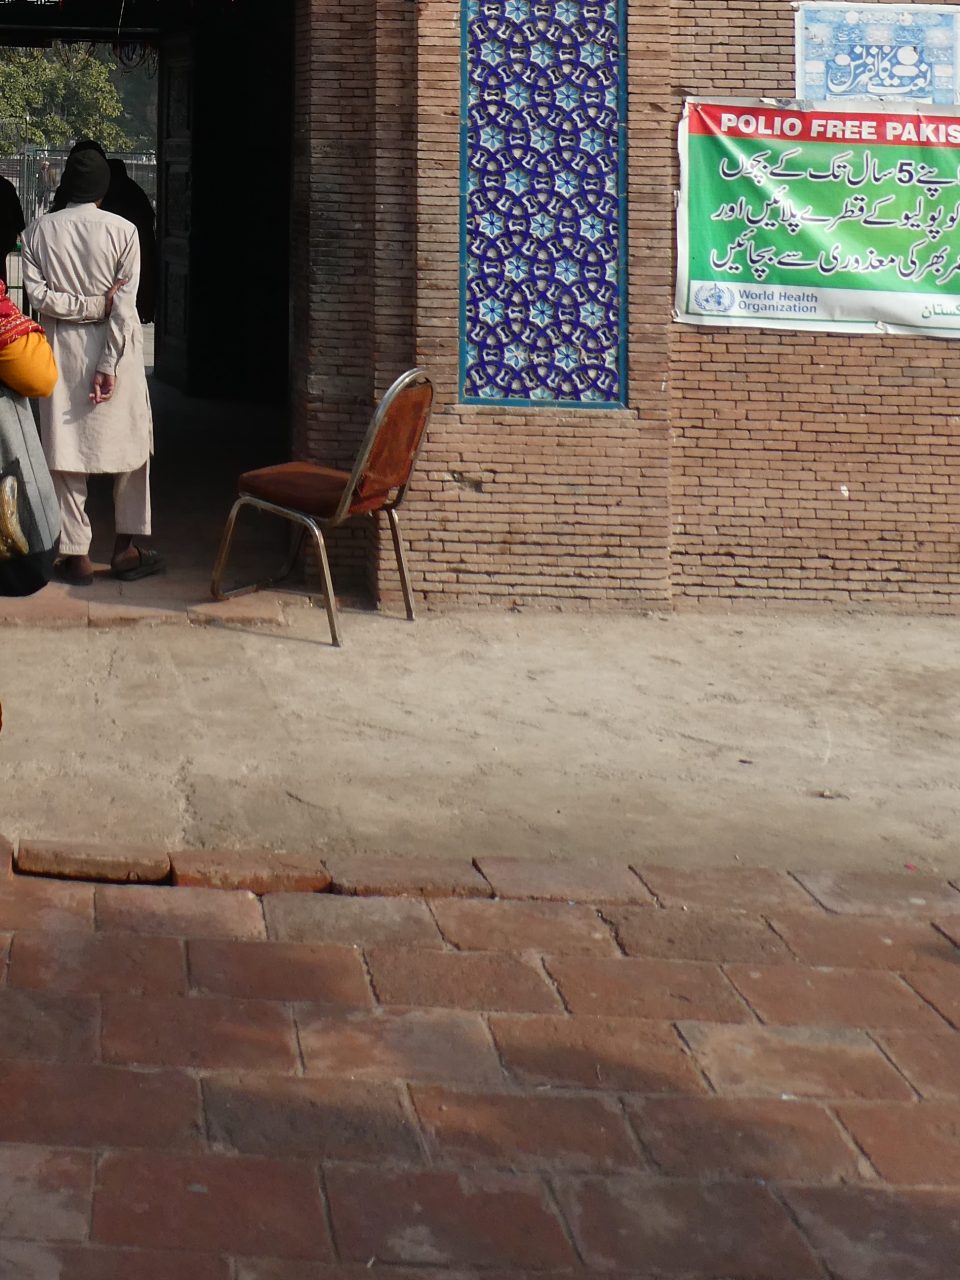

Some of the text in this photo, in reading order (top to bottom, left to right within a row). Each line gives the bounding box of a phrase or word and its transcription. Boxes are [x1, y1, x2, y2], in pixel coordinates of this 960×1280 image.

[720, 113, 803, 137] POLIO
[810, 119, 877, 140] FREE
[720, 147, 960, 198] پنے 5 سال تک کے بچوں
[711, 196, 745, 220] اور
[799, 194, 866, 232] قطرے
[862, 195, 898, 225] کے
[776, 251, 818, 270] سے
[818, 243, 896, 275] معذوری
[898, 238, 928, 280] کی
[739, 290, 818, 302] World Health
[739, 300, 817, 313] Organization
